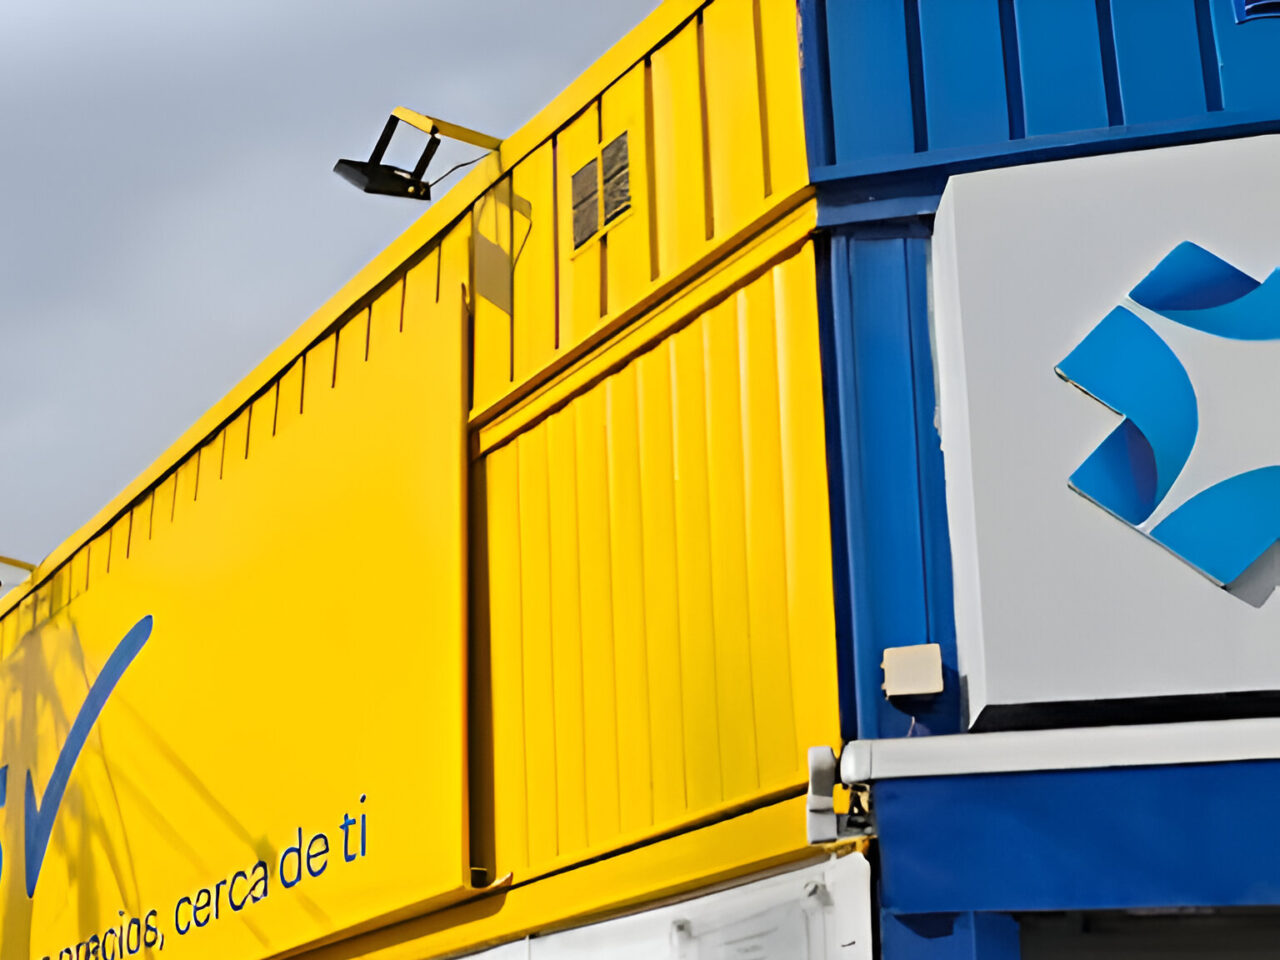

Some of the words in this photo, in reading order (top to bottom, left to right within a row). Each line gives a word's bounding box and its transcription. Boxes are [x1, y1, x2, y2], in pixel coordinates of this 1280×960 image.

[175, 860, 268, 935] cerca
[280, 827, 329, 888] de
[339, 794, 367, 862] ti
